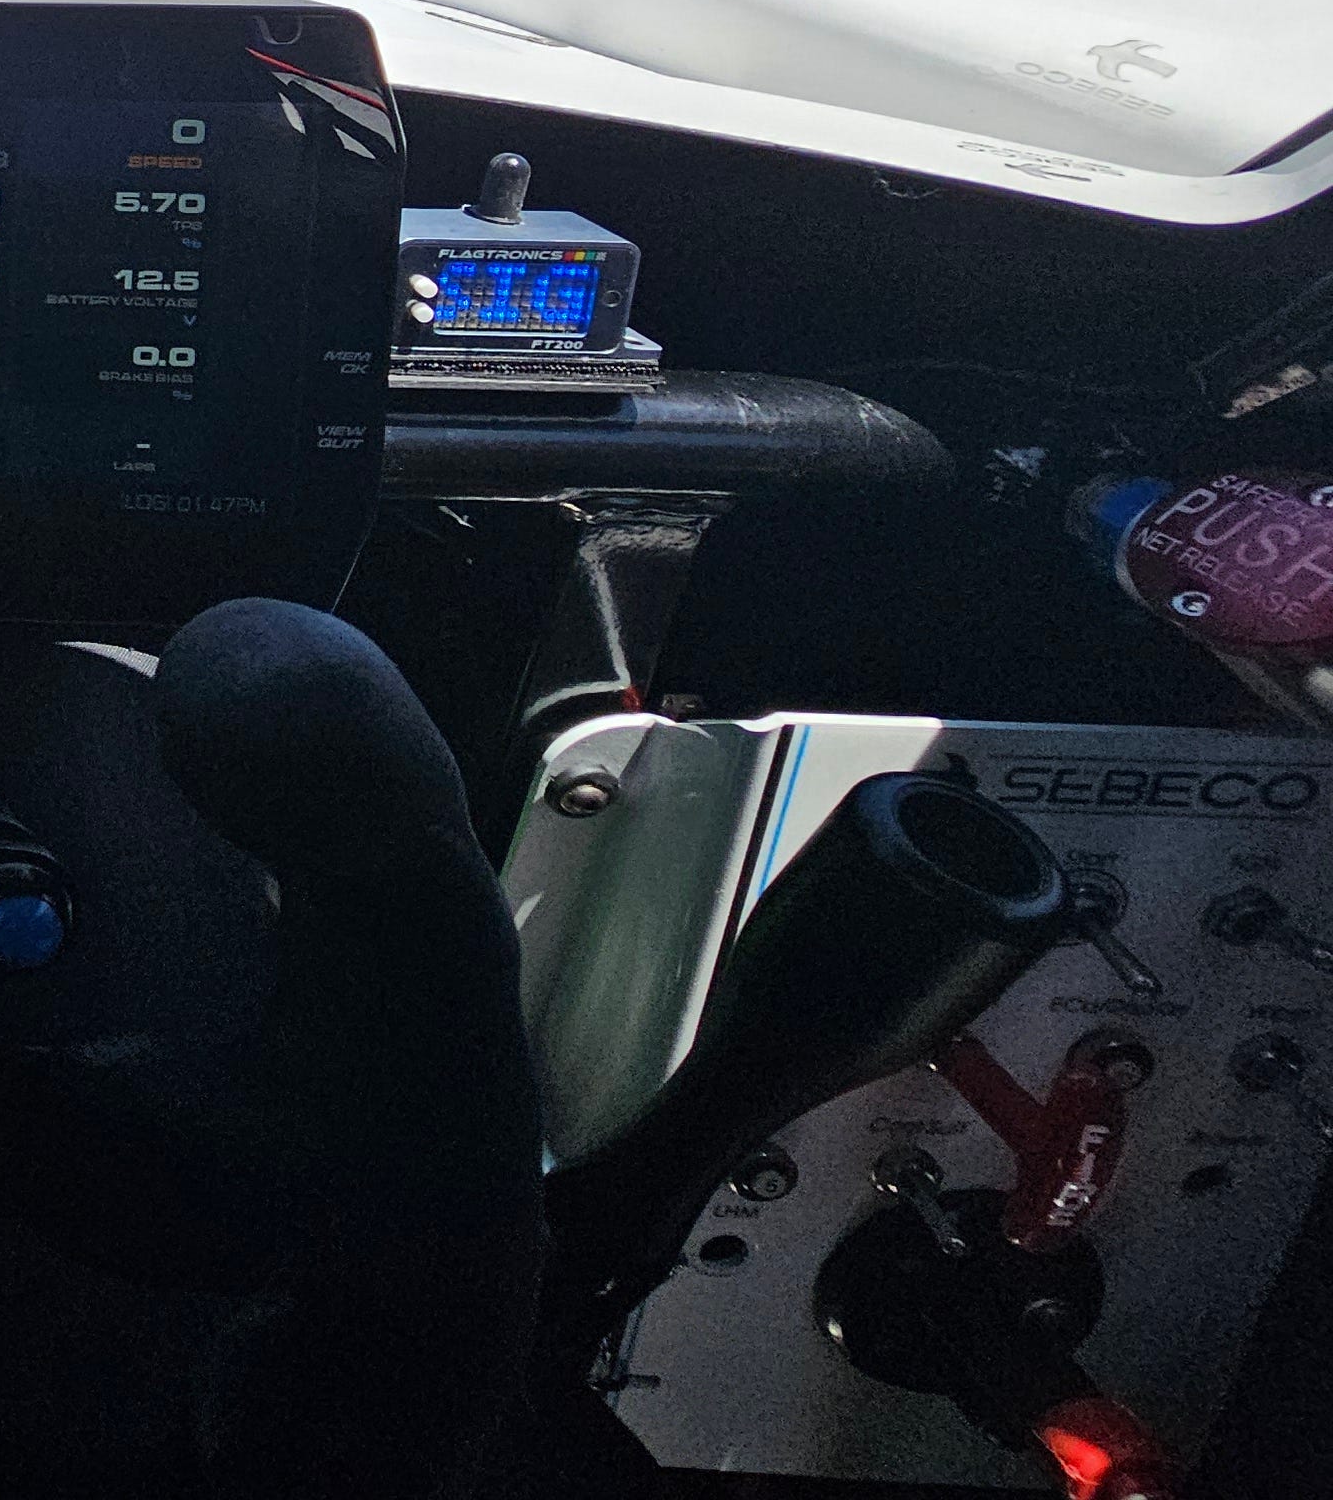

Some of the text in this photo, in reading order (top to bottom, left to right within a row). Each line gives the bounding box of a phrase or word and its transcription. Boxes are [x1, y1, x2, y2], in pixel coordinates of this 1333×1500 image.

[127, 156, 202, 169] SPEED
[114, 192, 206, 214] 5.70
[438, 249, 563, 261] FLAGTRONICS
[114, 269, 199, 291] 12.5
[531, 339, 584, 350] FT200
[132, 346, 196, 367] 0.0
[1136, 526, 1182, 557] NET
[998, 765, 1320, 811] SEBECO
